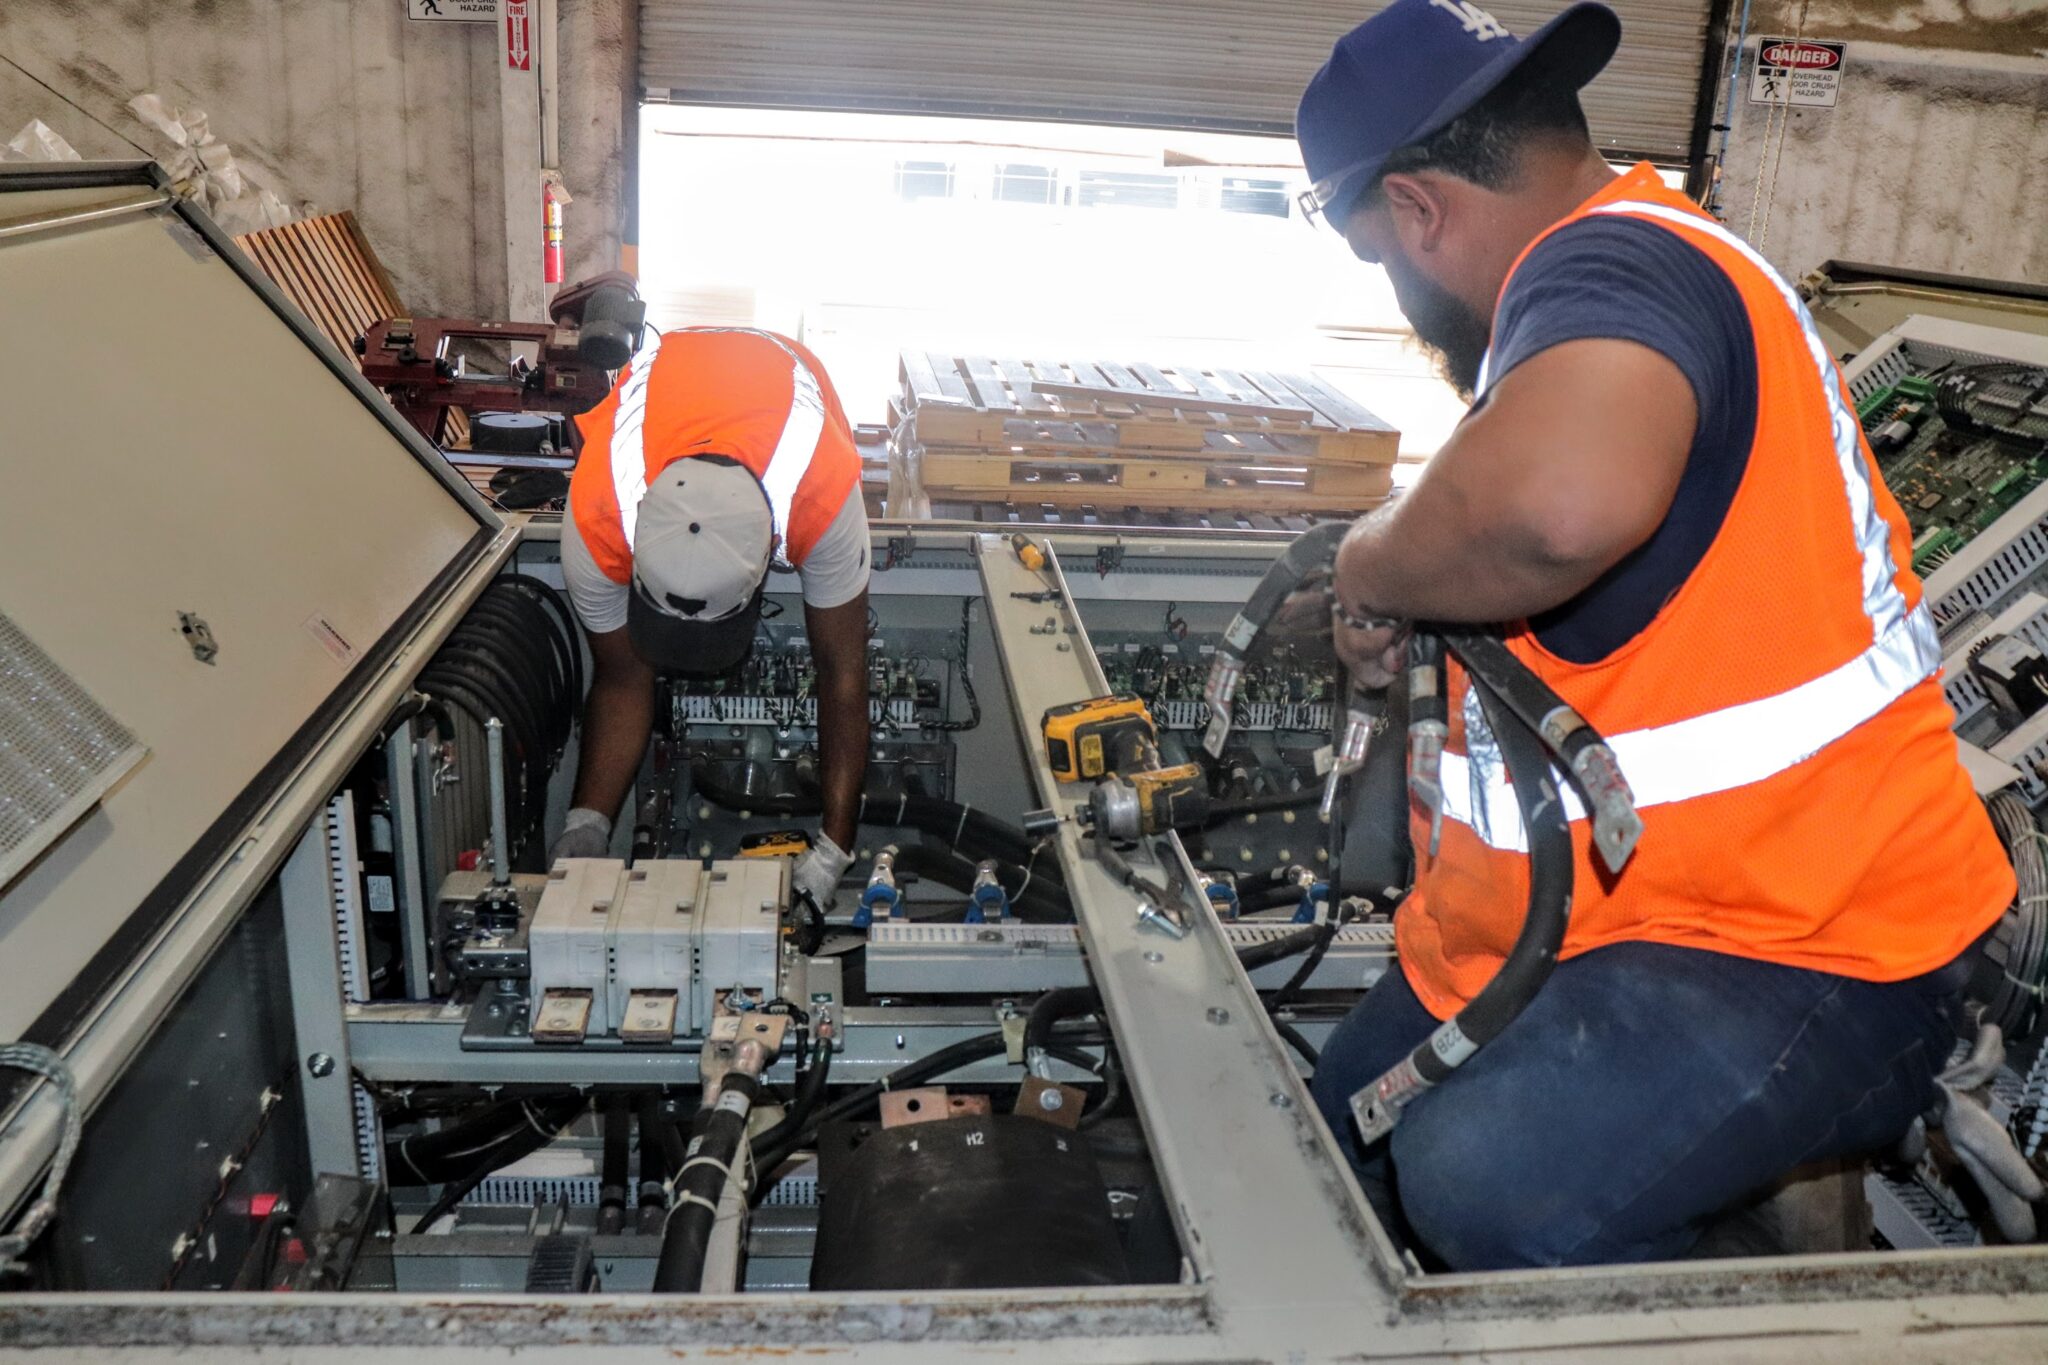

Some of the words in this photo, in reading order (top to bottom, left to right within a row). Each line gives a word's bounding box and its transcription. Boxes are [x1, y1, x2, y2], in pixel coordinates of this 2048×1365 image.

[460, 4, 496, 12] HAZARD
[509, 5, 525, 15] FIRE
[1769, 48, 1831, 64] DANGER
[1793, 72, 1833, 82] OVERHEAD
[1790, 81, 1809, 89] OOR
[1811, 82, 1836, 90] CRUSH
[1795, 89, 1826, 98] HAZARD
[966, 1131, 985, 1146] H2
